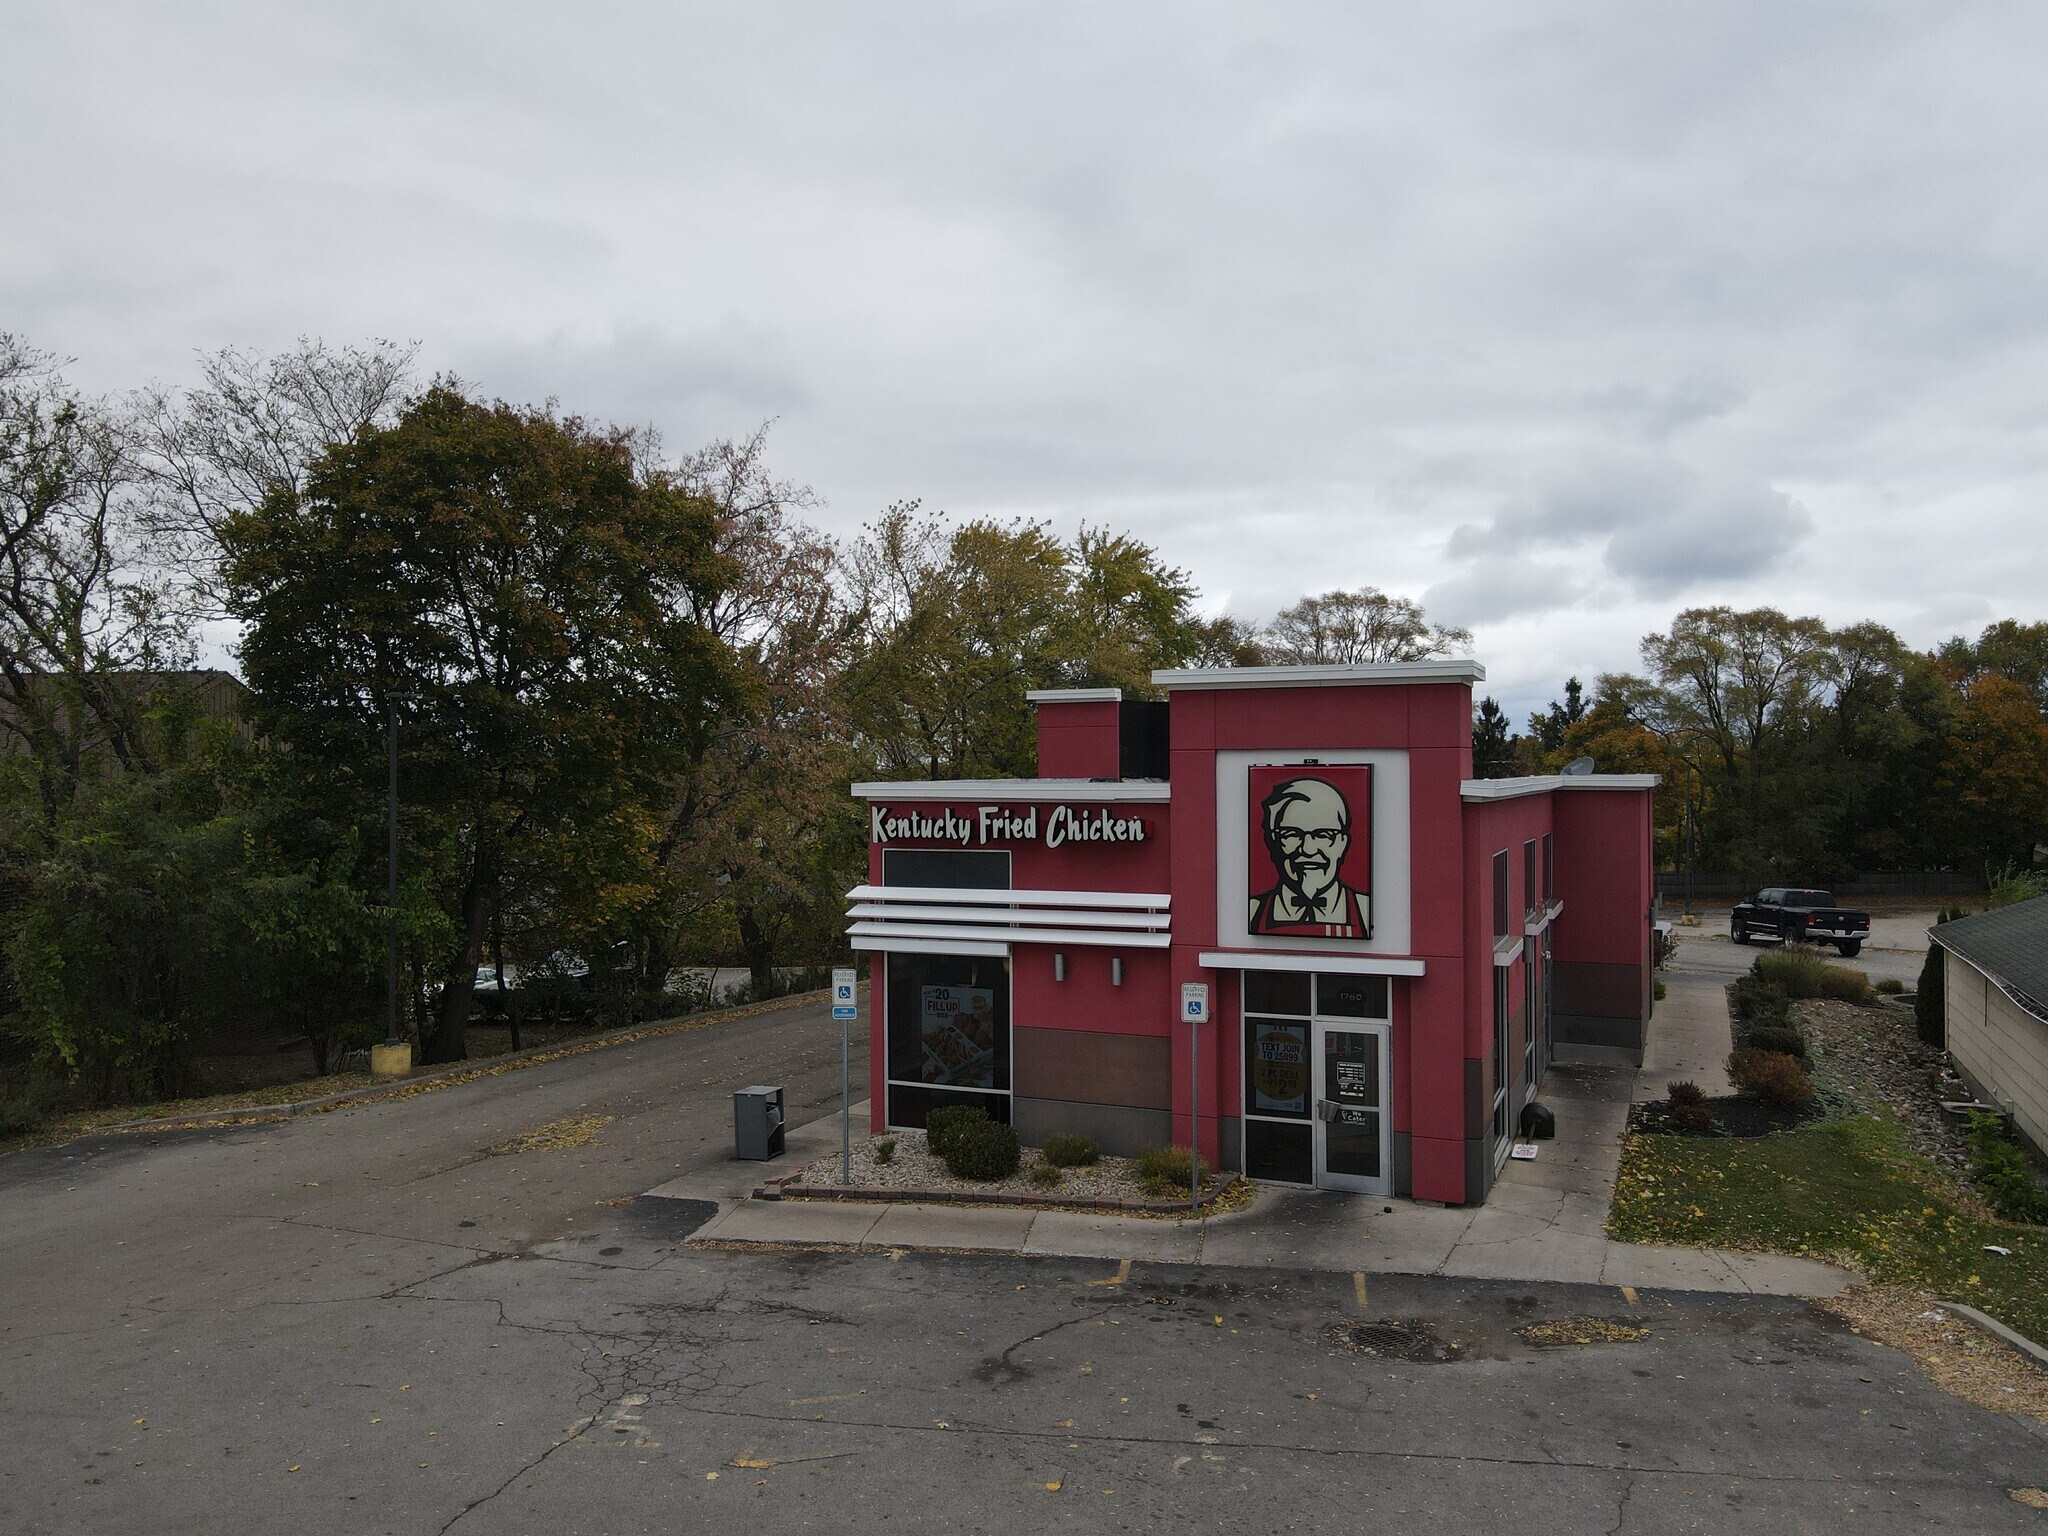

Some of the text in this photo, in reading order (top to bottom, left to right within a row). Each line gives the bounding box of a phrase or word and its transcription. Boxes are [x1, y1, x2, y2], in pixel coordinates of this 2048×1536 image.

[871, 805, 1144, 849] Kentucky Fried Chicken
[1341, 993, 1362, 1001] 1760
[927, 1000, 958, 1012] FILL UP
[1261, 1042, 1300, 1054] TEXT JOIN
[1262, 1051, 1298, 1062] TO 25899
[1267, 1068, 1278, 1078] PC
[1279, 1070, 1300, 1081] DEAL
